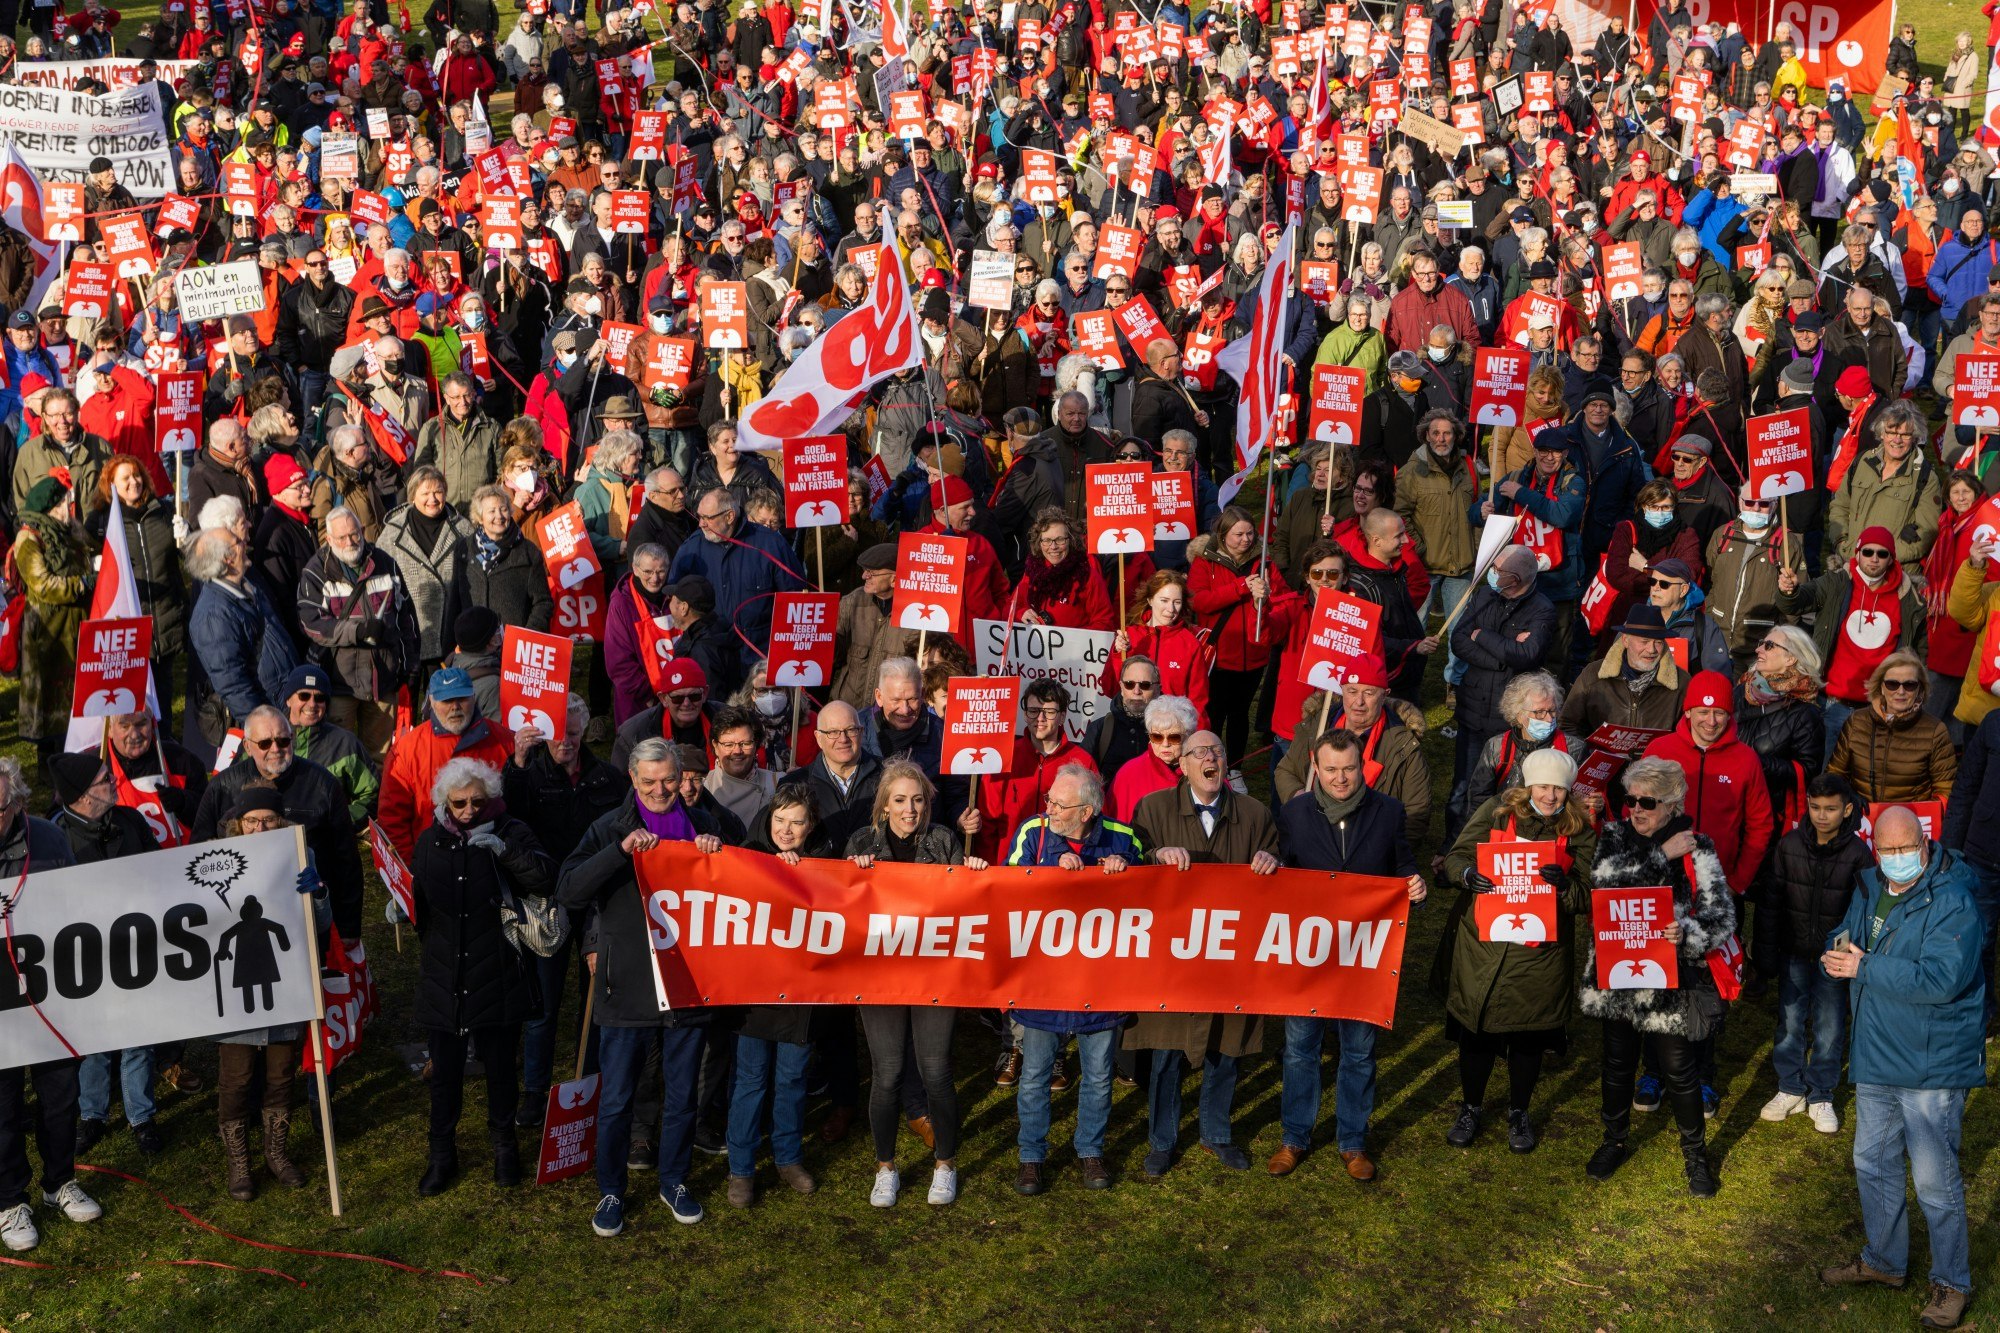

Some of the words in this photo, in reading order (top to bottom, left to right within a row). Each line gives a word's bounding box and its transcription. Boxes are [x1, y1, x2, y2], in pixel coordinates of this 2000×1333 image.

[1782, 2, 1840, 63] SP
[243, 52, 259, 66] SP
[600, 62, 614, 72] NEE
[641, 116, 661, 128] NEE
[1739, 124, 1758, 138] NEE
[1112, 137, 1131, 148] NEE
[1344, 140, 1362, 152] NEE
[388, 154, 411, 171] SP
[482, 154, 501, 170] NEE
[679, 162, 694, 176] NEE
[1353, 171, 1375, 186] NEE
[51, 188, 75, 202] NEE
[778, 187, 792, 200] NEE
[1107, 230, 1132, 246] NEE
[855, 250, 877, 264] NEE
[181, 269, 216, 291] AOW
[224, 272, 239, 282] en
[1309, 267, 1330, 280] NEE
[184, 284, 261, 301] minimumloon
[711, 288, 736, 304] NEE
[188, 300, 229, 318] BLIJFT
[235, 296, 261, 311] EEN
[1122, 303, 1147, 325] NEE
[1530, 298, 1554, 316] NEE
[1083, 317, 1105, 333] NEE
[608, 327, 633, 344] NEE
[146, 346, 179, 370] SP
[658, 343, 684, 360] NEE
[1183, 347, 1211, 371] SP
[1487, 356, 1519, 375] NEE
[1966, 362, 1998, 378] NEE
[1319, 373, 1358, 385] INDEXATIE
[1476, 380, 1524, 390] ONTKOPPELING
[1491, 374, 1512, 382] TEGEN
[167, 380, 194, 398] NEE
[1328, 383, 1348, 392] VOOR
[1492, 388, 1508, 396] AOW
[1957, 384, 2000, 392] ONTKOPPELIN
[172, 399, 189, 407] TEGEN
[1324, 392, 1351, 402] IEDERE
[1317, 400, 1357, 412] GENERATIE
[1768, 420, 1789, 431] GOED
[1758, 427, 1800, 440] PENSIOEN
[804, 445, 825, 454] GOED
[1762, 443, 1798, 457] KWESTIE
[794, 453, 836, 464] PENSIOEN
[1754, 456, 1771, 466] VAN
[1772, 450, 1807, 463] FATSOEN
[798, 472, 834, 482] KWESTIE
[1094, 473, 1144, 485] INDEXATIE
[789, 482, 806, 492] VAN
[808, 479, 843, 490] FATSOEN
[1106, 484, 1132, 494] VOOR
[1152, 479, 1181, 495] NEE
[1102, 494, 1137, 505] IEDERE
[1153, 501, 1191, 509] TKOPPELING
[1093, 504, 1146, 516] GENERATIE
[544, 513, 574, 540] NEE
[1524, 516, 1554, 546] SP
[921, 542, 944, 553] GOED
[909, 552, 955, 565] PENSIOEN
[910, 571, 949, 584] KWESTIE
[900, 580, 918, 591] VAN
[920, 581, 958, 594] FATSOEN
[558, 595, 597, 628] SP
[787, 603, 825, 624] NEE
[1337, 601, 1359, 616] GOED
[1324, 608, 1367, 629] PENSIOEN
[792, 624, 817, 634] TEGEN
[94, 628, 137, 652] NEE
[774, 633, 832, 643] ONTKOPPELING
[988, 625, 1064, 660] STOP
[1084, 639, 1108, 664] de
[1312, 634, 1331, 648] VAN
[1323, 628, 1360, 648] KWESTIE
[793, 642, 813, 651] AOW
[101, 652, 129, 663] TEGEN
[516, 641, 555, 671] NEE
[80, 658, 145, 672] ONTKOPPELING
[102, 669, 123, 680] AOW
[520, 667, 547, 679] TEGEN
[503, 672, 565, 693] ONTKOPPELING
[521, 686, 541, 699] AOW
[955, 687, 1011, 701] INDEXATIE
[968, 699, 997, 712] VOOR
[962, 711, 1000, 722] IEDERE
[951, 720, 1009, 734] GENERATIE
[1609, 730, 1653, 742] NEE
[1494, 853, 1540, 874] NEE
[1501, 876, 1532, 887] TEGEN
[1489, 885, 1552, 895] TKOPPELING
[1506, 894, 1528, 903] AOW
[1609, 899, 1657, 921] NEE
[648, 888, 846, 956] STRIJD
[863, 914, 990, 961] MEE
[1008, 908, 1154, 959] VOOR
[1170, 909, 1241, 961] JE
[1254, 912, 1393, 970] AOW
[1619, 922, 1650, 931] TEGEN
[1624, 940, 1646, 949] AOW
[0, 902, 212, 1010] BOOS
[549, 1116, 594, 1138] GENERATIE
[556, 1130, 586, 1148] IEDERE
[558, 1141, 580, 1156] VOOR
[545, 1149, 588, 1172] INDEXATIE
